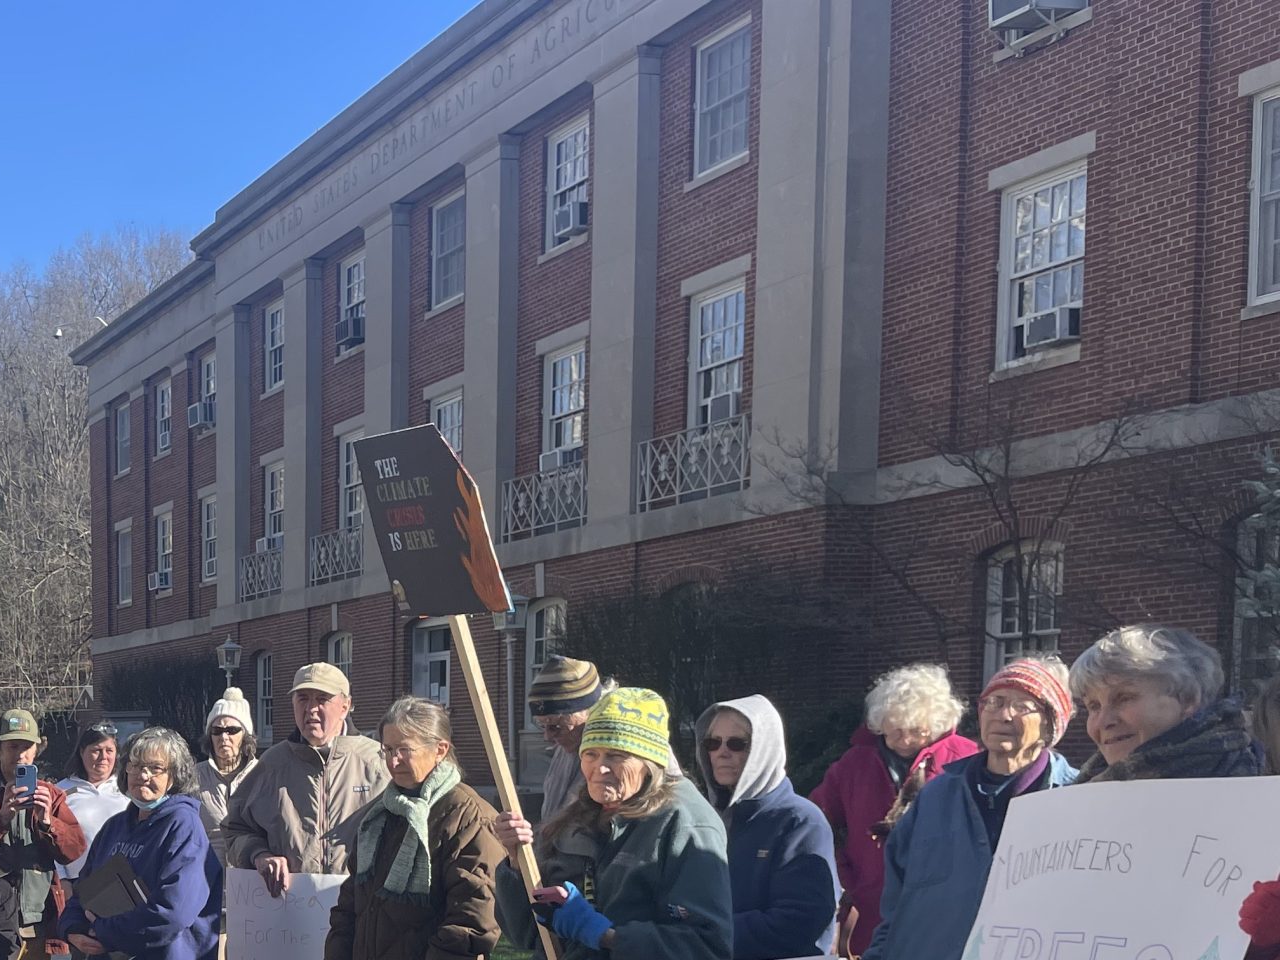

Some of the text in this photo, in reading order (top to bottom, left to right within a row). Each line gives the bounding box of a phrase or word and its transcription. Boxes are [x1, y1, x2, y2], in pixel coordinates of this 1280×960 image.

[258, 204, 303, 251] UNITED
[313, 165, 358, 213] STATES
[370, 80, 479, 175] DEPARTMENT
[491, 54, 516, 89] OF
[374, 456, 400, 479] THE
[376, 476, 432, 502] CLIMATE
[388, 529, 438, 551] IS HERE
[994, 834, 1243, 902] MOUNTAINEERS FOR
